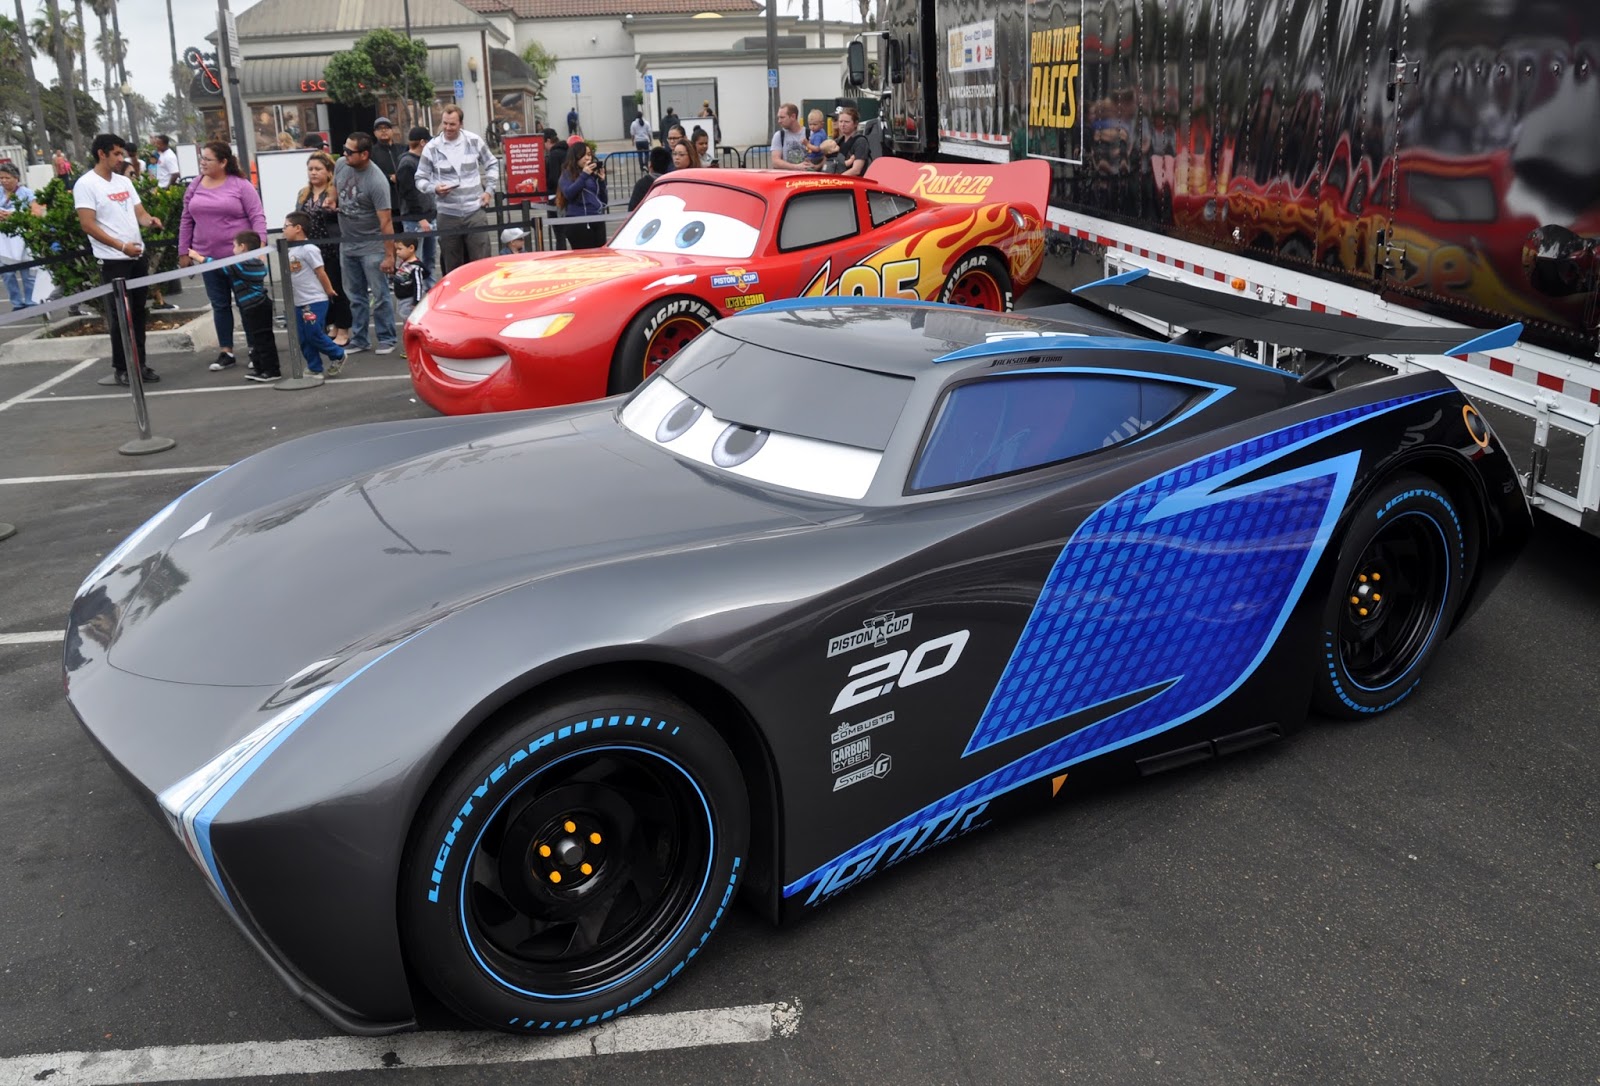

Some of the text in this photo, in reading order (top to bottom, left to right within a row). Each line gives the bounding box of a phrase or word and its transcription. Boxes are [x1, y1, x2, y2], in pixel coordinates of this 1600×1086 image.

[1030, 25, 1080, 64] ROAD TO THE
[1029, 63, 1079, 128] RACES
[713, 274, 756, 285] PISTON CUP
[643, 300, 718, 341] LIGHTYEA
[1376, 488, 1452, 520] LIGHTYEAR
[830, 617, 910, 653] PISTON CUP
[832, 713, 893, 742] COMBUSTR
[832, 738, 869, 764] CARBON
[833, 751, 869, 771] CYBER
[428, 731, 556, 903] LIGHTYEAR
